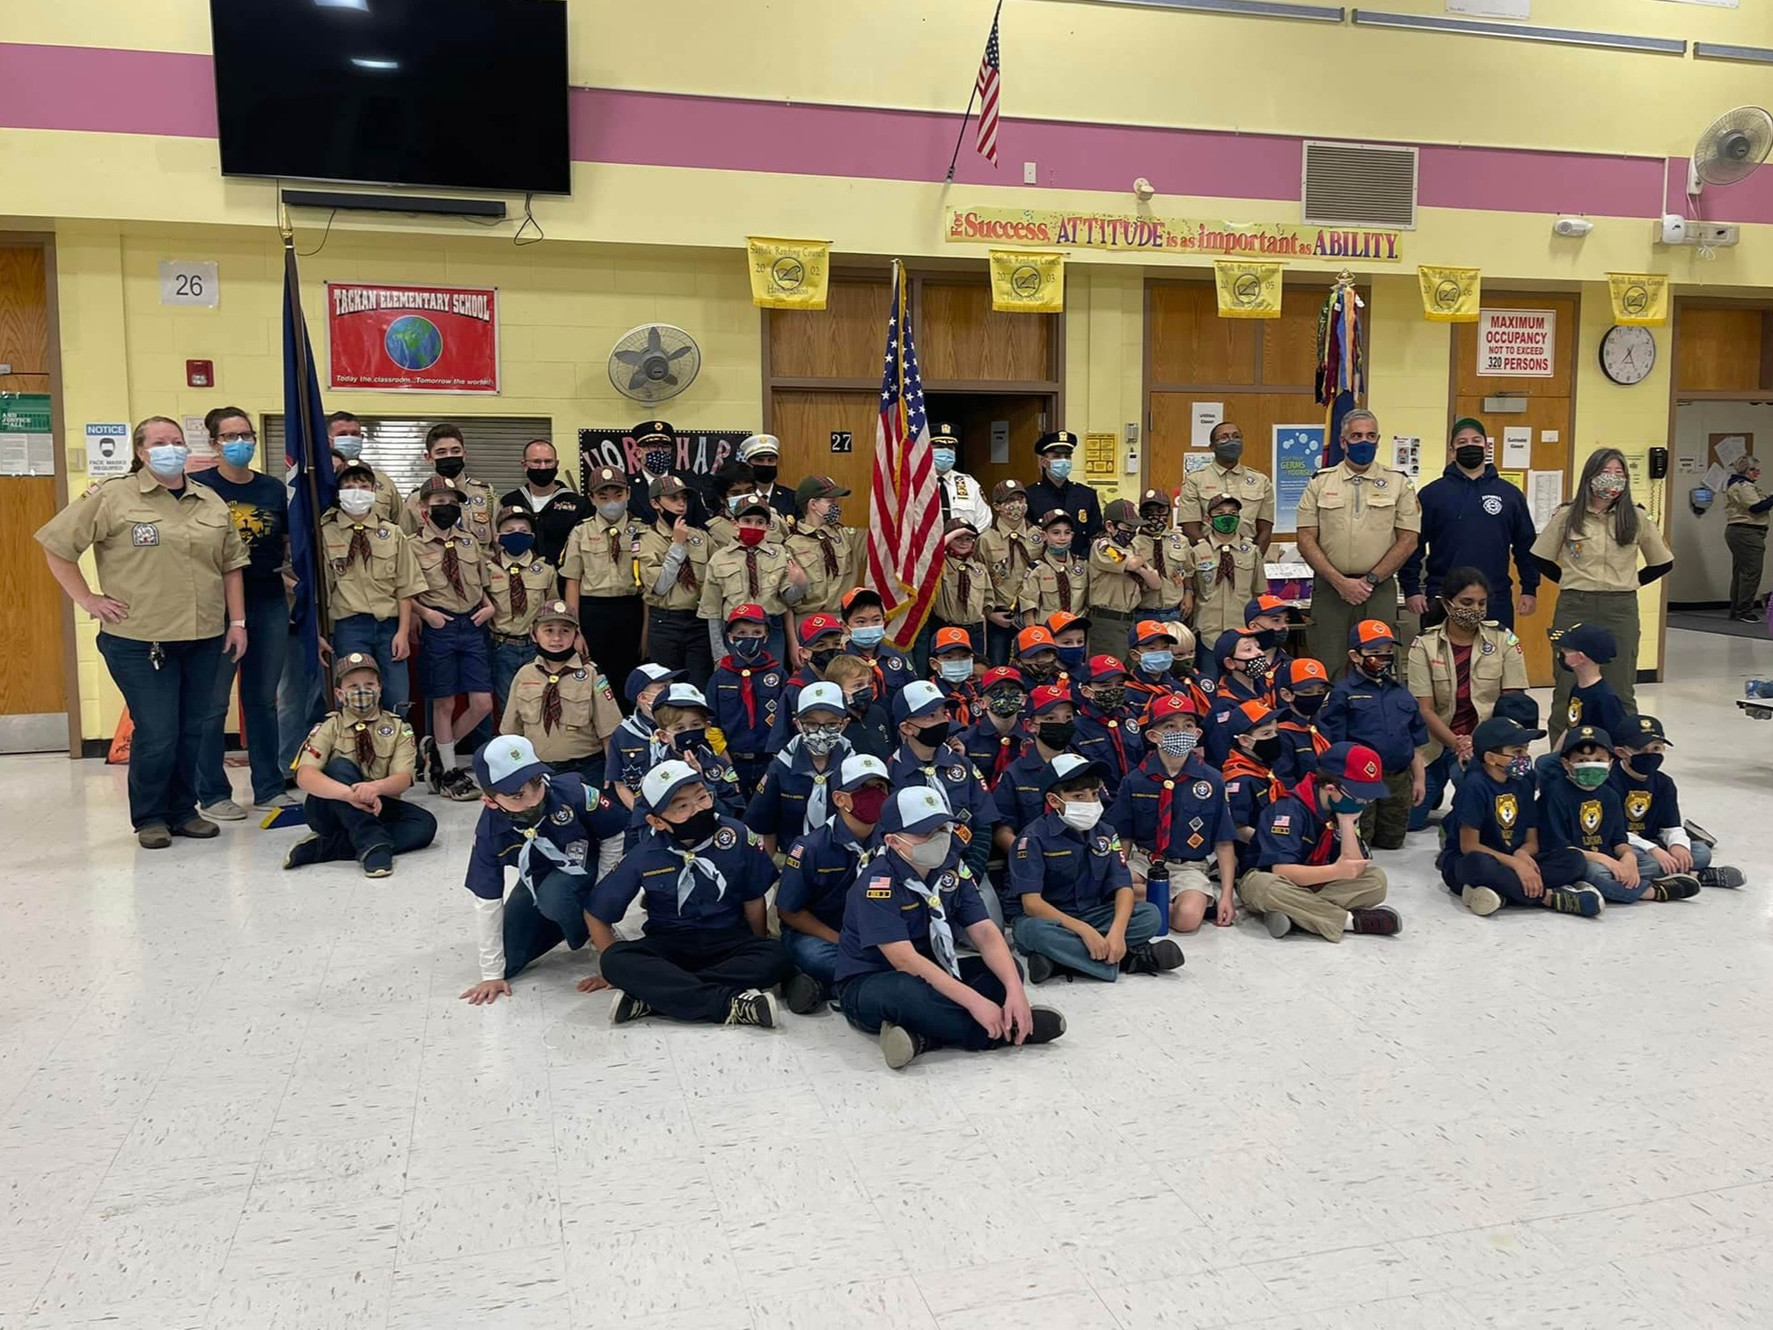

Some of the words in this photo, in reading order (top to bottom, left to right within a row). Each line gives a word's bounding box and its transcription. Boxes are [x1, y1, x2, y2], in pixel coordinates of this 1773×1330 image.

[1056, 216, 1166, 247] ATTITUDE
[1166, 233, 1178, 248] is
[1180, 235, 1196, 248] as
[1197, 223, 1299, 254] important
[1299, 242, 1312, 255] as
[755, 263, 766, 273] 20
[176, 274, 203, 296] 26
[334, 289, 377, 316] TACKAN
[379, 291, 450, 312] ELEMENTARY
[452, 294, 490, 322] SCHOOL
[1490, 316, 1545, 329] MAXIMUM
[1486, 331, 1548, 344] OCCUPANCY
[1488, 346, 1504, 354] NOT
[1505, 346, 1515, 354] TO
[1516, 346, 1544, 355] EXCEED
[1488, 356, 1502, 368] 320
[1503, 358, 1549, 371] PERSONS
[336, 374, 358, 384] Today
[87, 425, 125, 434] NOTICE
[832, 434, 851, 450] 27
[600, 797, 610, 808] 5
